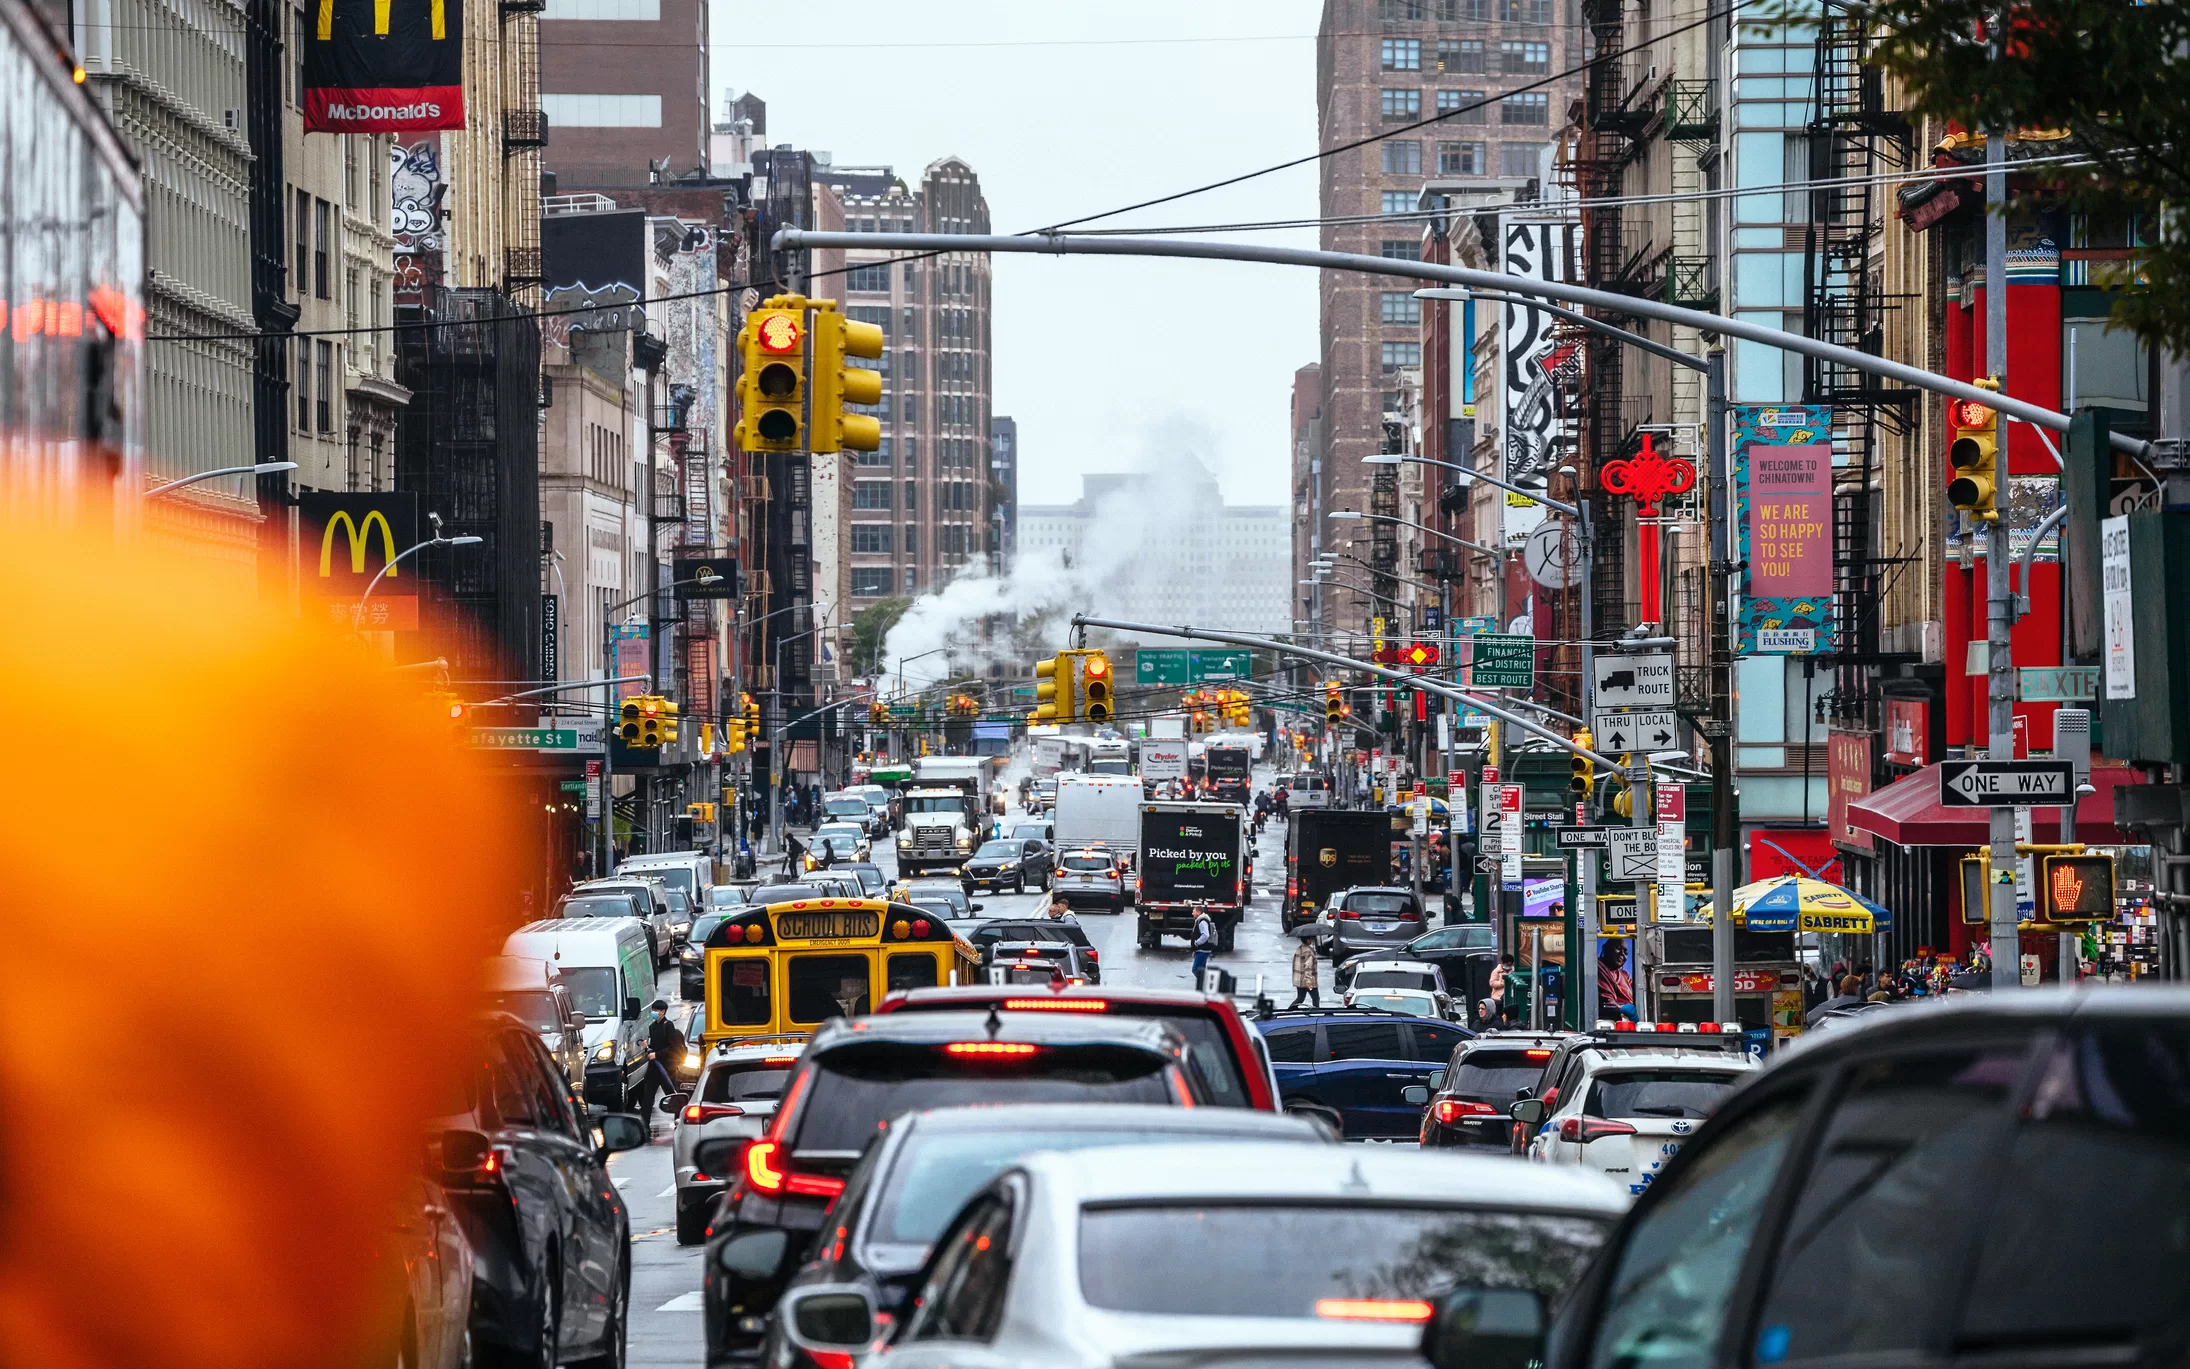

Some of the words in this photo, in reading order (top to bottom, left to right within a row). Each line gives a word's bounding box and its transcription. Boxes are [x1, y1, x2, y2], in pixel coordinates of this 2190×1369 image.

[328, 101, 440, 120] McDonald's
[1759, 461, 1804, 471] WELCOME
[1806, 460, 1817, 471] TO
[1759, 473, 1815, 484] CHINATOWN!
[1760, 505, 1780, 520] WE
[1784, 504, 1809, 520] ARE
[1760, 524, 1777, 539] SO
[1780, 523, 1823, 539] HAPPY
[1760, 543, 1776, 558] TO
[1780, 543, 1804, 558] SEE
[1761, 562, 1791, 577] YOU!
[1501, 638, 1526, 647] DRIVE
[1763, 638, 1809, 646] FLUSHING
[1487, 648, 1532, 658] FINANCIAL
[1496, 660, 1531, 669] DISTRICT
[1637, 666, 1669, 677] TRUCK
[1476, 674, 1497, 684] BEST
[1501, 675, 1528, 684] ROUTE
[2021, 671, 2096, 697] BAXTE
[1638, 684, 1670, 695] ROUTE
[1603, 717, 1630, 727] THRU
[1640, 715, 1672, 726] LOCAL
[545, 733, 562, 745] St
[1154, 753, 1179, 761] Ryder
[1962, 775, 2000, 792] ONE
[2018, 775, 2057, 792] WAY
[1487, 812, 1502, 832] 2
[1658, 823, 1664, 834] 3
[1566, 833, 1586, 841] ONE
[1594, 833, 1608, 841] WA
[1614, 831, 1639, 841] DON'T
[1642, 831, 1658, 841] BLO
[1624, 843, 1640, 853] THE
[1644, 843, 1658, 852] BO
[1149, 848, 1186, 859] Picked
[1189, 849, 1203, 861] by
[1205, 852, 1227, 861] you
[1321, 854, 1336, 864] ups
[1176, 858, 1205, 875] packed
[1208, 858, 1219, 877] by
[1685, 862, 1702, 870] tion
[1532, 885, 1551, 896] YouTube
[1658, 885, 1664, 895] 5
[1803, 893, 1843, 904] SABRETT
[1617, 906, 1637, 917] ONE
[783, 913, 837, 937] SCHOOL
[843, 914, 871, 937] BUS
[1804, 915, 1869, 929] SABRETT
[1548, 975, 1555, 985] P
[1708, 981, 1756, 990] FOD
[1662, 1143, 1682, 1155] 40
